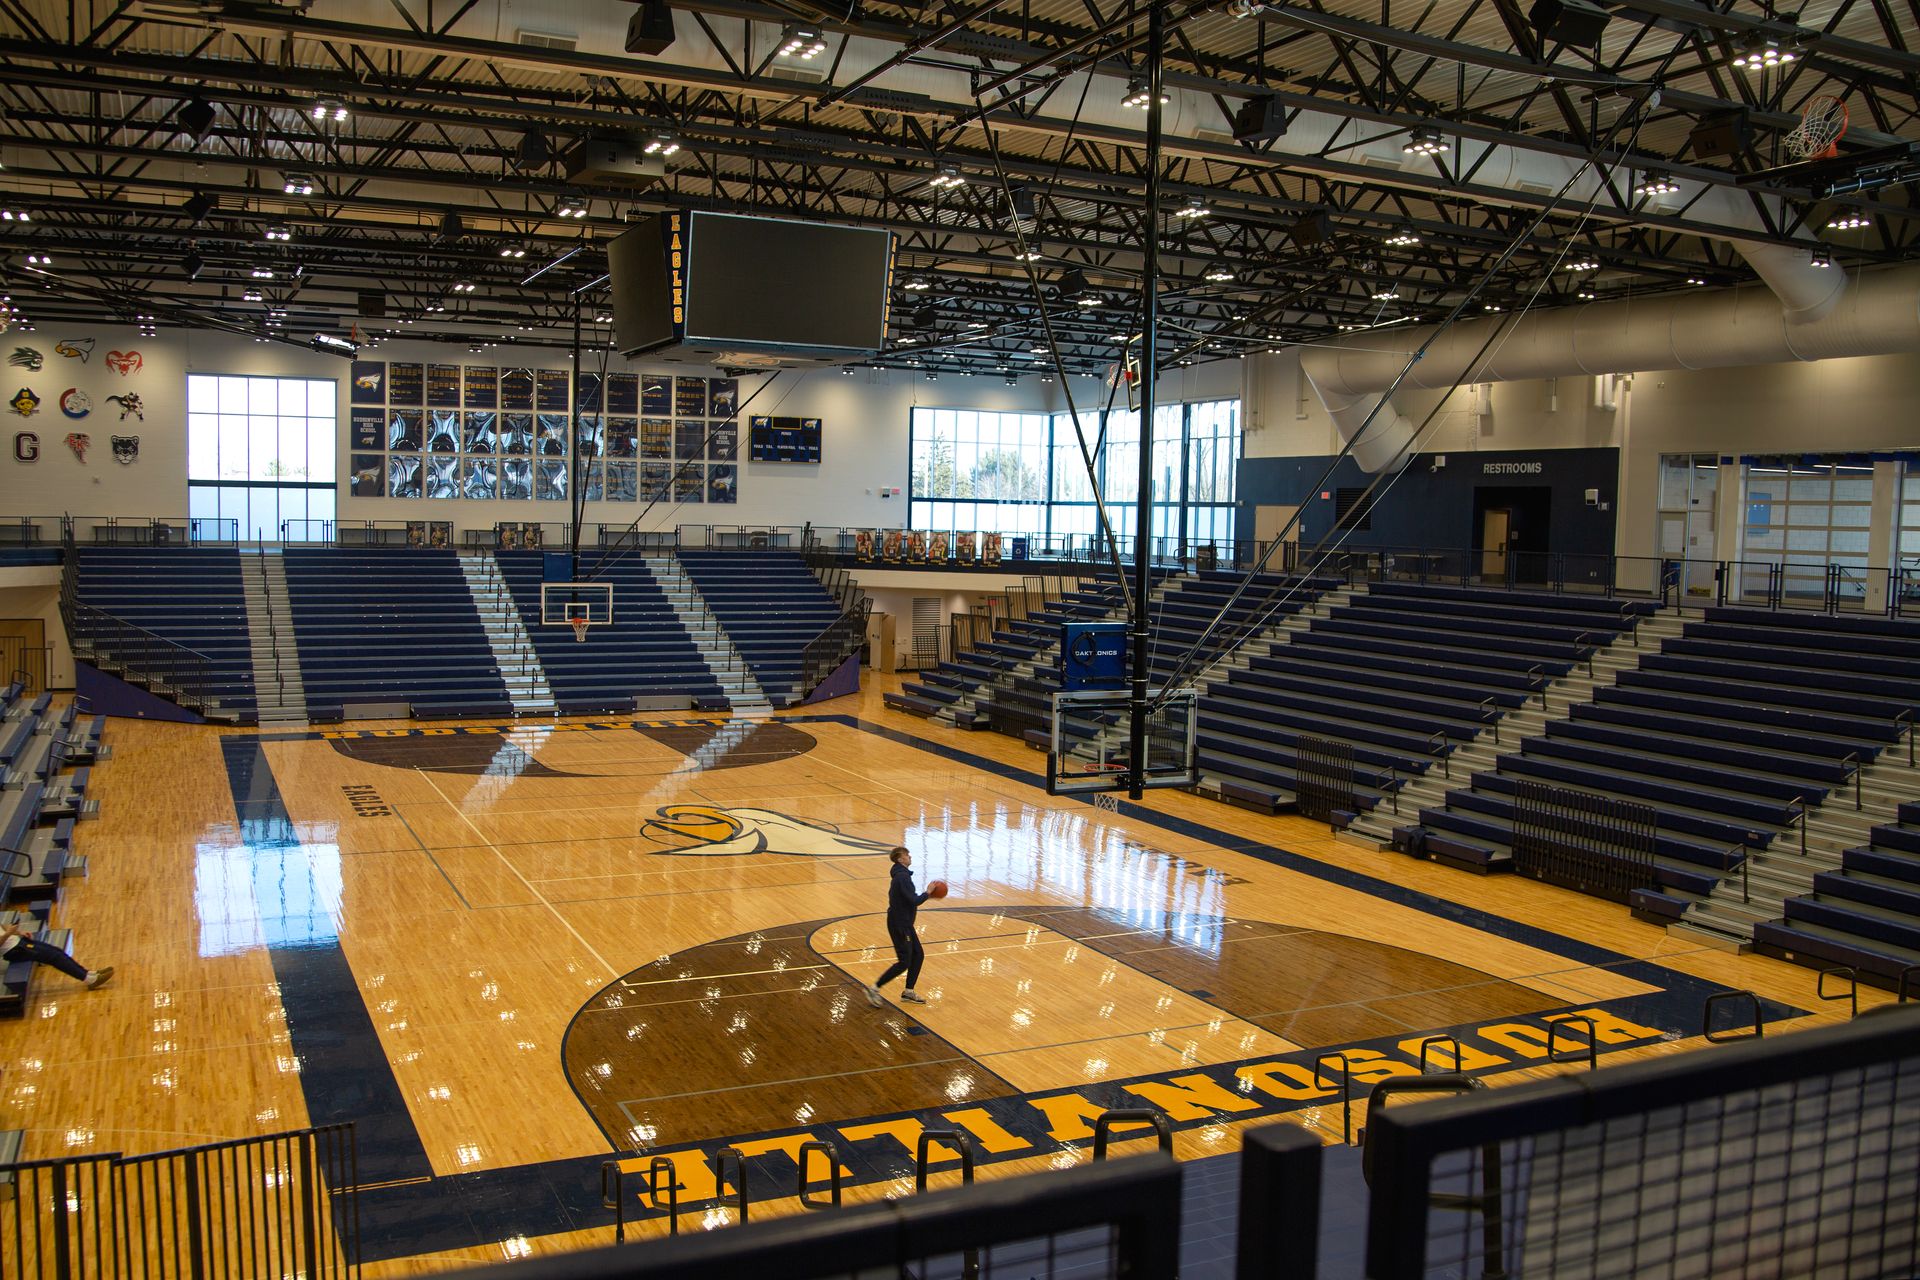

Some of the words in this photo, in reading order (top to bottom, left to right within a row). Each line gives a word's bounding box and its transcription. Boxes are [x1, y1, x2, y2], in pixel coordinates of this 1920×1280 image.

[671, 214, 683, 324] EAGLES
[13, 431, 41, 463] G
[1483, 462, 1542, 474] RESTROOMS
[341, 785, 392, 817] EAGLES
